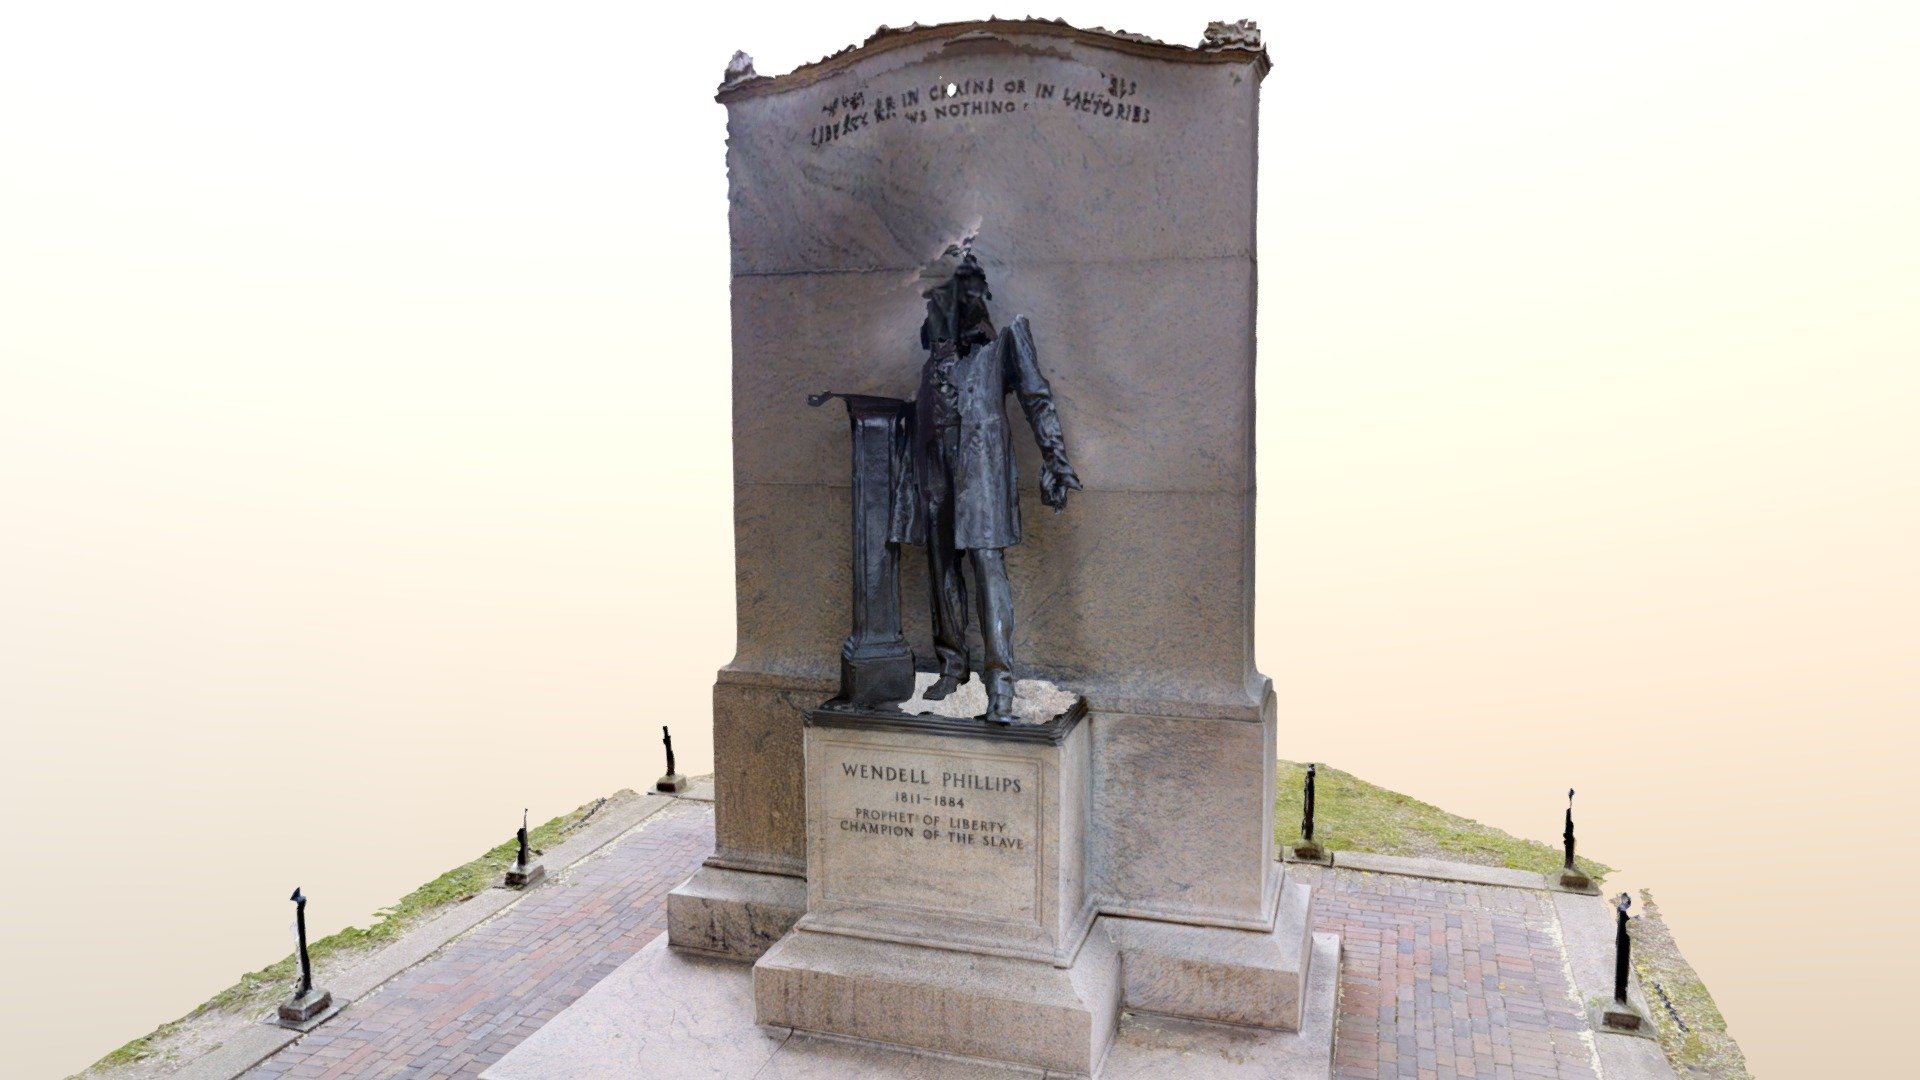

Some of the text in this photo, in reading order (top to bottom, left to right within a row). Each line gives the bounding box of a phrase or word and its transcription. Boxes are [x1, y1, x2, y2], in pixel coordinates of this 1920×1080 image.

[902, 87, 919, 108] IN
[1004, 79, 1026, 94] OR
[1036, 82, 1055, 98] IN
[934, 101, 1015, 119] NOTHING
[842, 763, 1022, 793] WENDELL PHILLIPS
[840, 820, 1025, 850] CHAMPION OF THE SLAVE
[855, 808, 1007, 833] PROPHET OF LIBERTY
